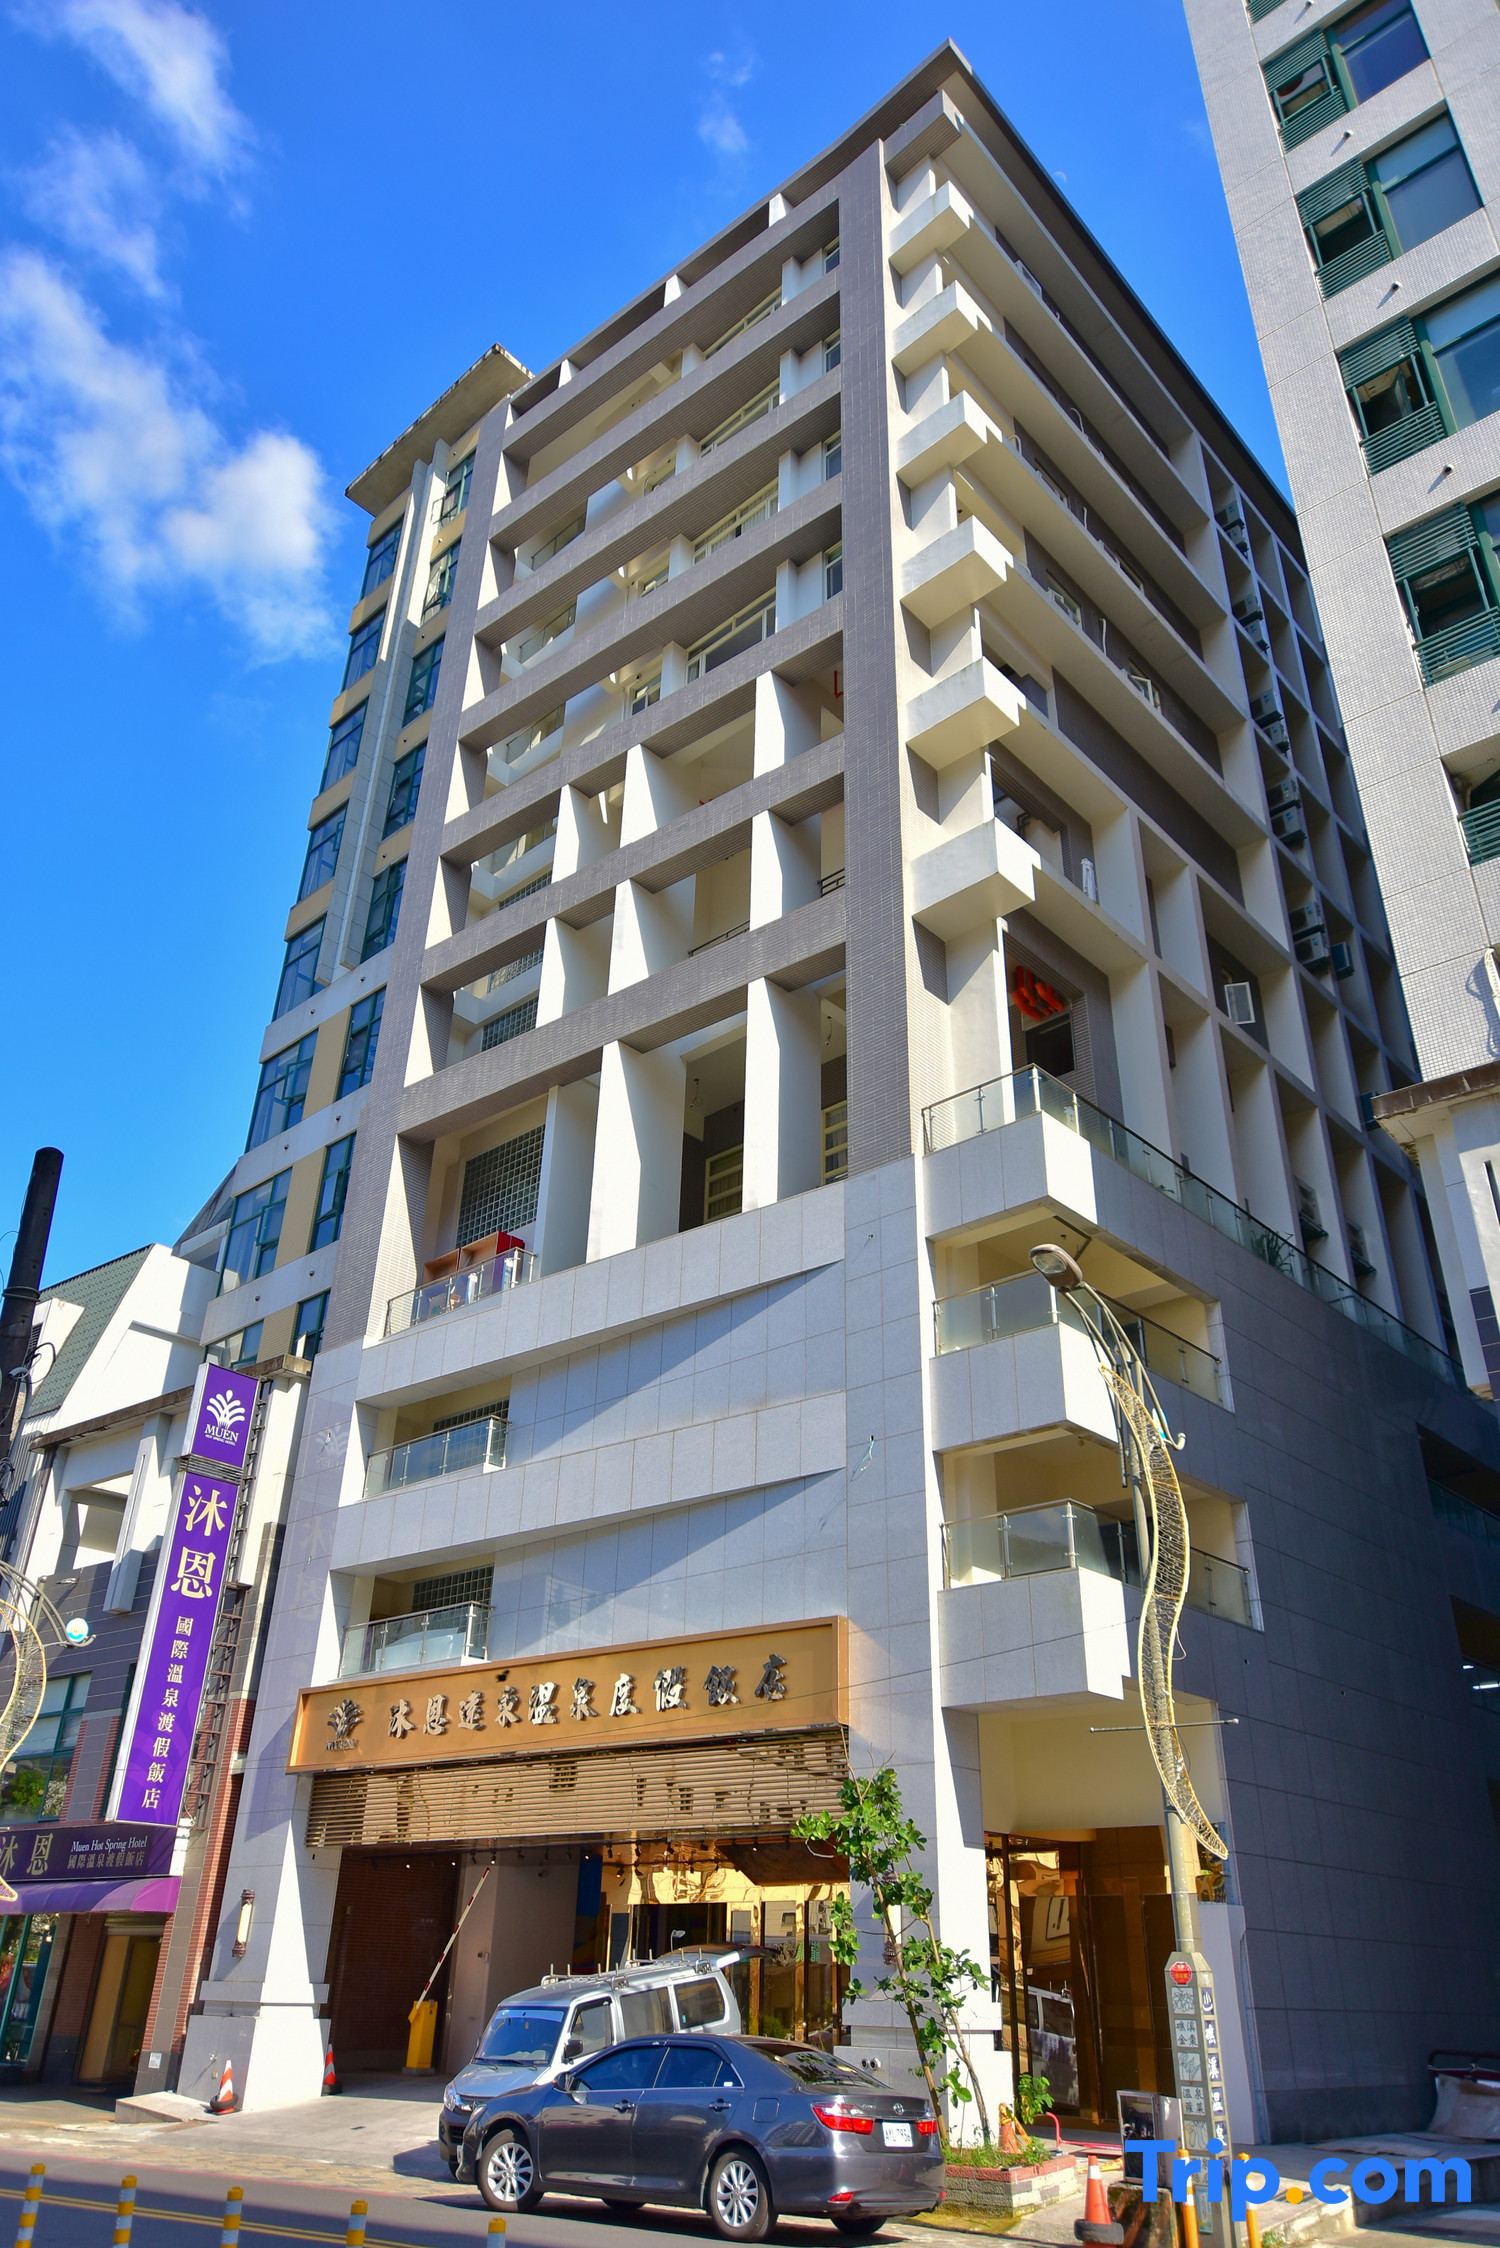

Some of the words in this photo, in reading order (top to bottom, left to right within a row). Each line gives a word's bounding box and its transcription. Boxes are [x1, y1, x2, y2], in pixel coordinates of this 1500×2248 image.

[204, 1423, 239, 1442] MUEN
[171, 1485, 228, 1599] 沐恩
[141, 1615, 194, 1809] 國際溫泉渡假飯店
[70, 1841, 90, 1852] Muen
[91, 1839, 104, 1851] Hot
[105, 1838, 127, 1853] Spring
[128, 1835, 148, 1848] Hotel
